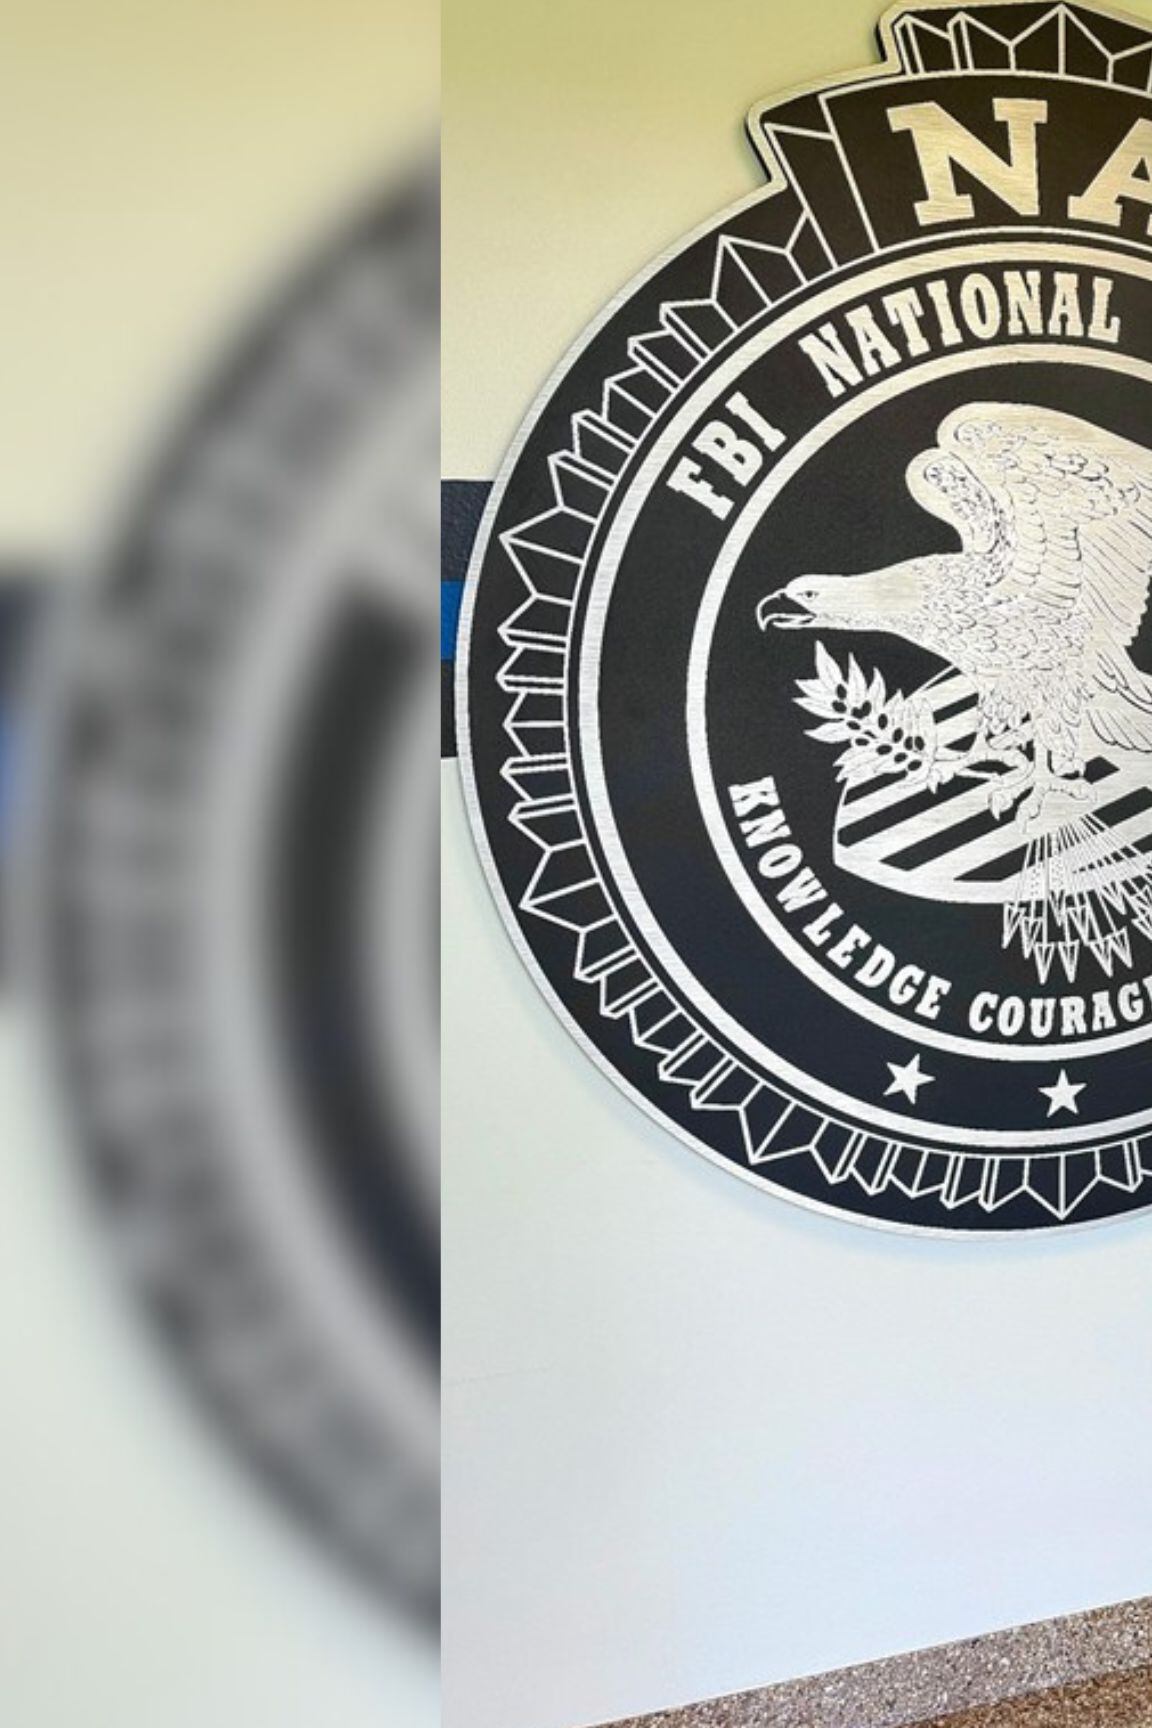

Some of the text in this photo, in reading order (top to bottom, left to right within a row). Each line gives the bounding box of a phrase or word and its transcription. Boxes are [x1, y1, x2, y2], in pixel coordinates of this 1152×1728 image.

[666, 391, 787, 521] FBI
[798, 269, 1120, 397] NATIONAL
[728, 776, 952, 1020] KNOWLEDGE
